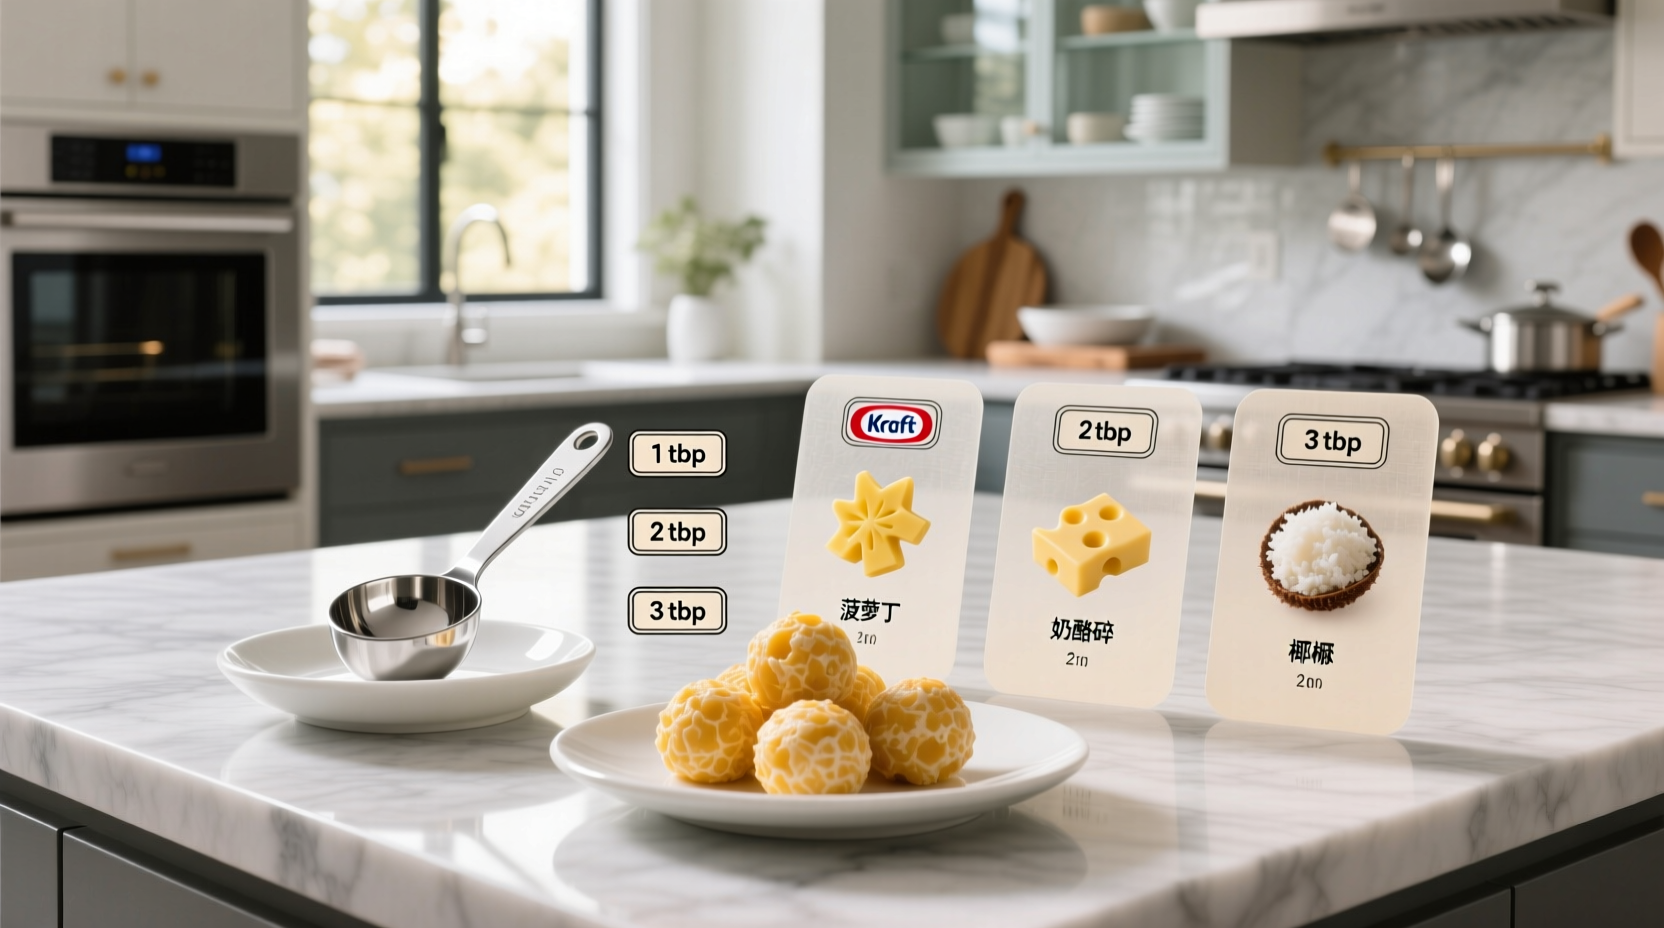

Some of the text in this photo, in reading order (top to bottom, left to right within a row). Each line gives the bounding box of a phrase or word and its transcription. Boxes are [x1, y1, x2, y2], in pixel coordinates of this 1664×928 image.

[867, 413, 917, 434] Kraft
[1078, 419, 1132, 447] 2 tbp
[1304, 429, 1362, 457] 3 tbp
[1050, 616, 1115, 645] 奶酪碎
